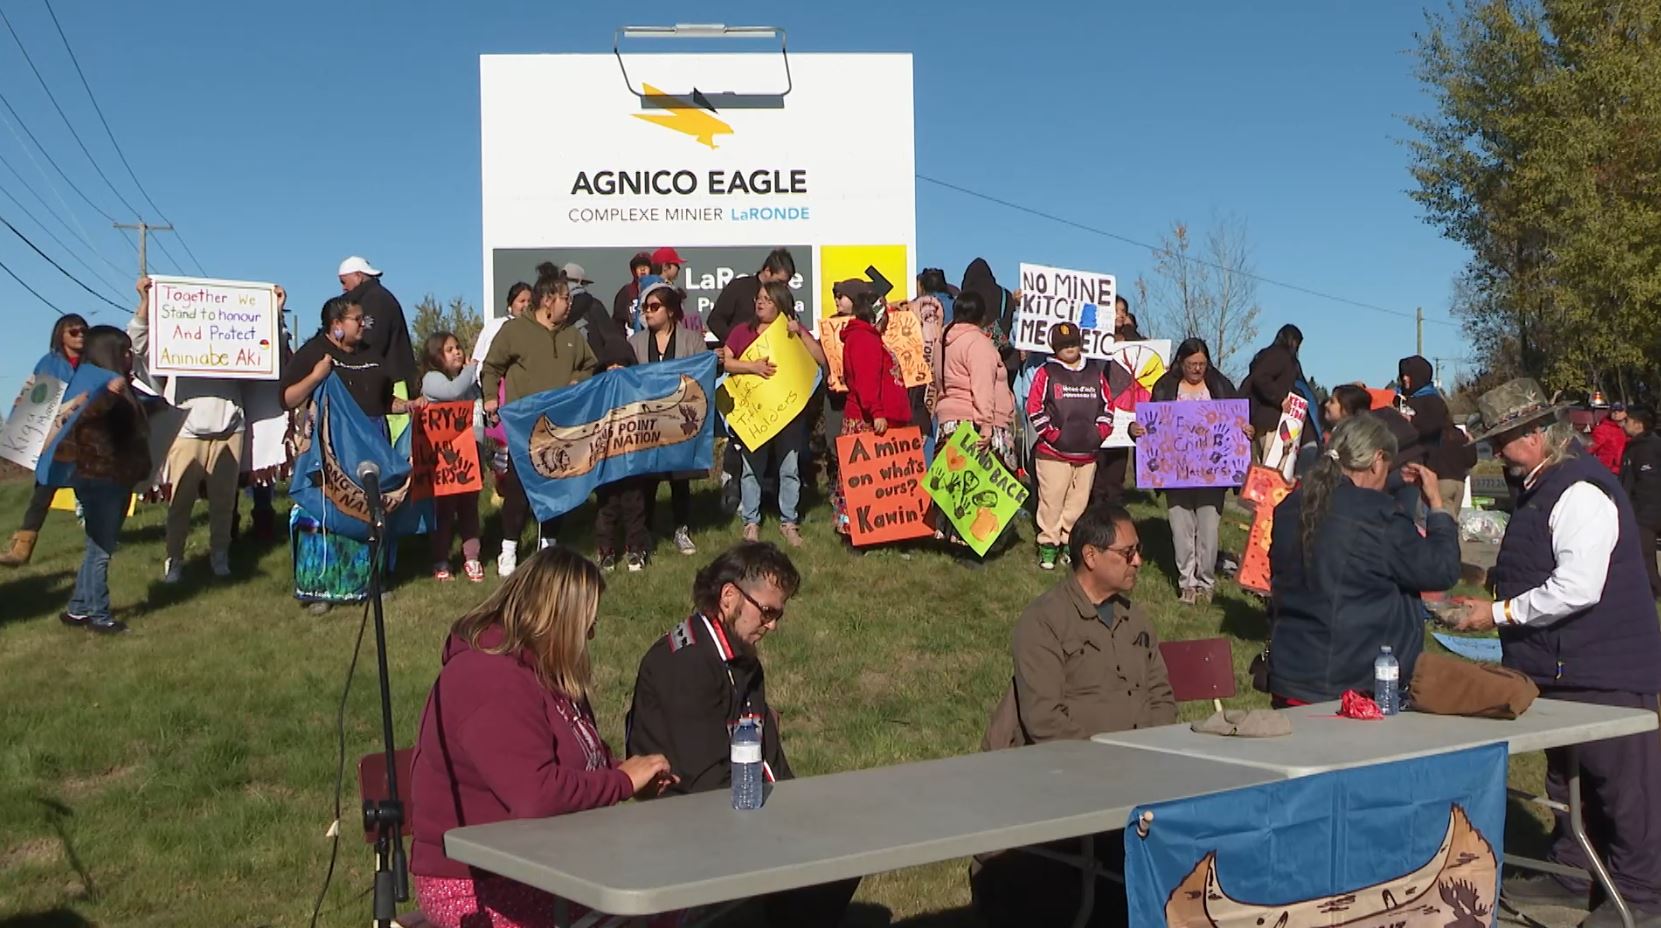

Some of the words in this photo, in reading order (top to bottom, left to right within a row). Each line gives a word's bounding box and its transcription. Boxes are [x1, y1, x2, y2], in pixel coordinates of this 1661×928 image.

[570, 170, 698, 195] AGNICO
[708, 169, 807, 195] EAGLE
[568, 207, 659, 223] COMPLEXE
[665, 207, 723, 222] MINIER
[731, 206, 811, 222] LaRONDE
[685, 267, 804, 290] LaRe
[1023, 271, 1047, 294] NO
[163, 285, 228, 308] Together
[161, 304, 196, 319] Stand
[201, 308, 216, 320] to
[219, 309, 261, 322] honour
[173, 324, 202, 340] And
[210, 325, 256, 341] Protect
[236, 348, 261, 366] Aki
[748, 390, 798, 439] Holders
[619, 418, 658, 436] POINT
[613, 430, 662, 450] NATION
[848, 437, 871, 465] A
[874, 436, 922, 459] mine
[848, 473, 873, 488] on
[879, 456, 924, 481] what's
[875, 479, 918, 499] ours?
[989, 469, 1026, 504] BACK
[856, 498, 925, 534] Kawin!
